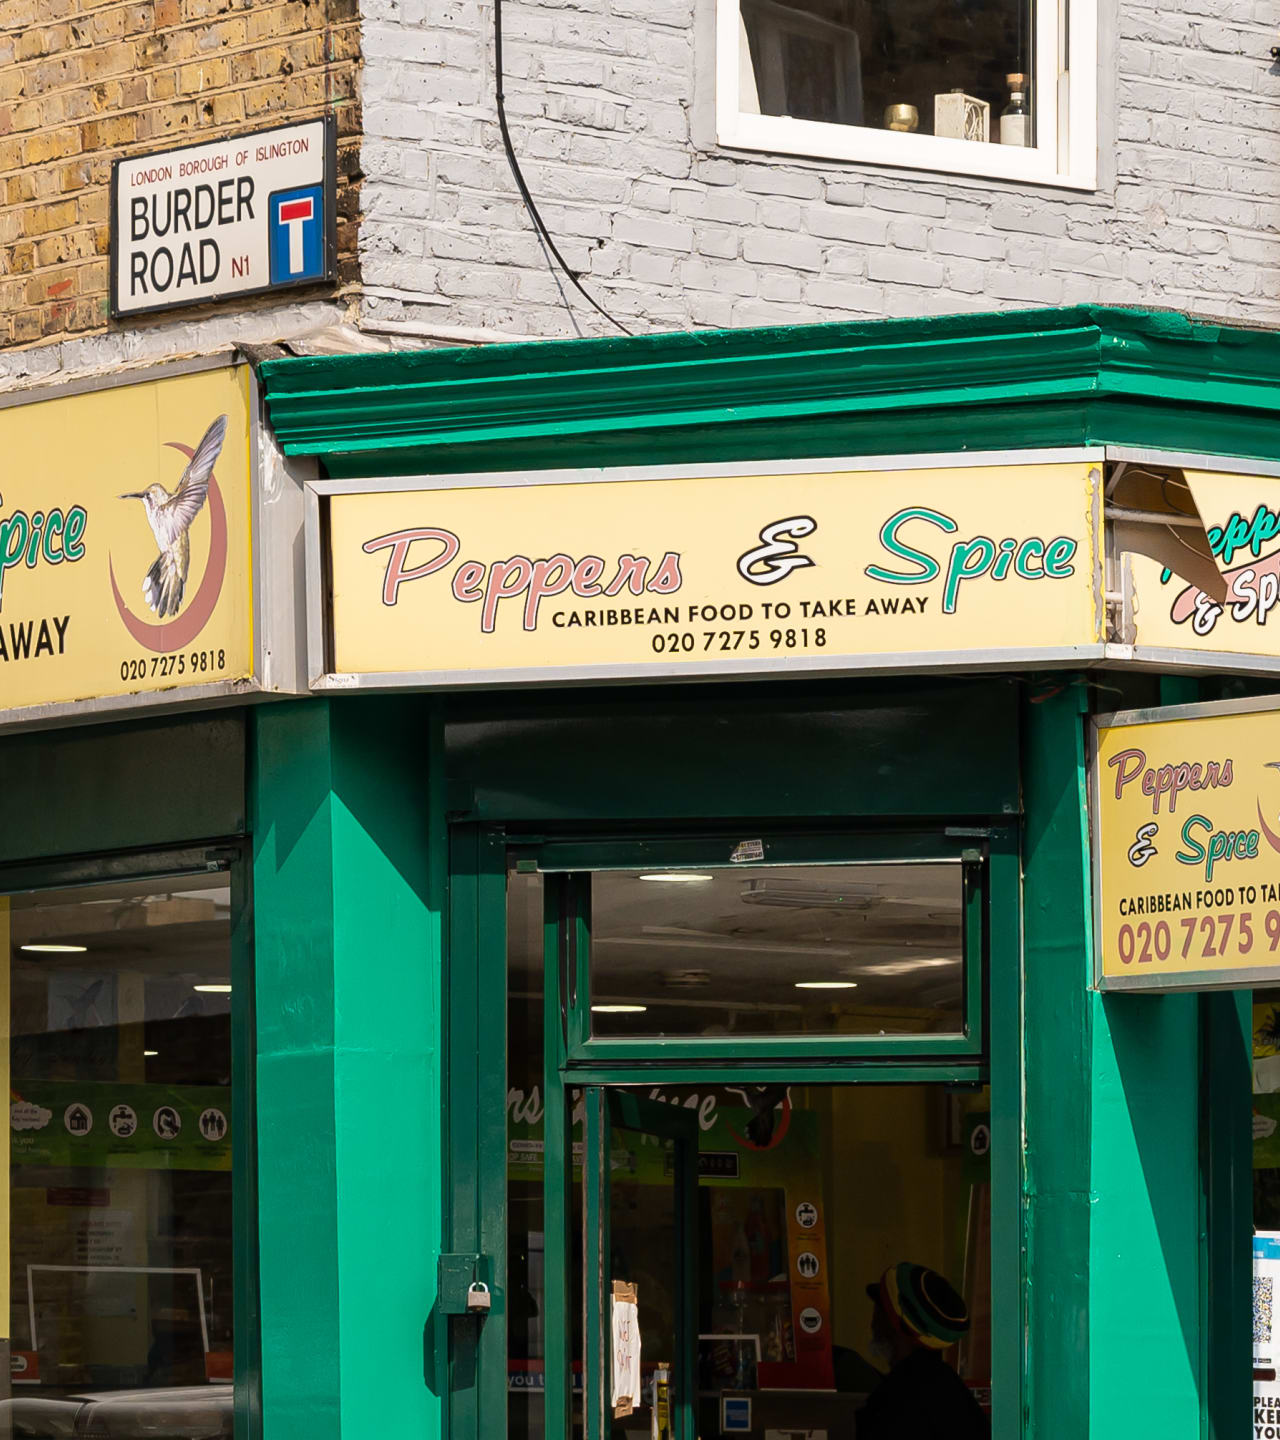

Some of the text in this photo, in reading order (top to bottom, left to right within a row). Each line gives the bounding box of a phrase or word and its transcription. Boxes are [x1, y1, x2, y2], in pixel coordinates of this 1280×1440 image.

[131, 138, 309, 187] LONDON BOROUGH OF ISLINGTON
[131, 175, 255, 242] BURDER
[130, 238, 250, 296] ROAD N1
[362, 506, 1078, 633] Peppers & Spice
[552, 595, 930, 629] CARIBBEAN FOOD TO TAKE AWAY
[120, 649, 226, 682] 020 7275 9818
[651, 626, 827, 654] 020 7275 9818
[1108, 747, 1233, 814] Peppers
[1128, 814, 1260, 882] & Spice
[1119, 891, 1192, 917] CARIBBEAN
[1196, 888, 1234, 909] FOOD
[1238, 886, 1256, 905] TO
[1118, 920, 1171, 964] 020
[1180, 913, 1253, 960] 7275
